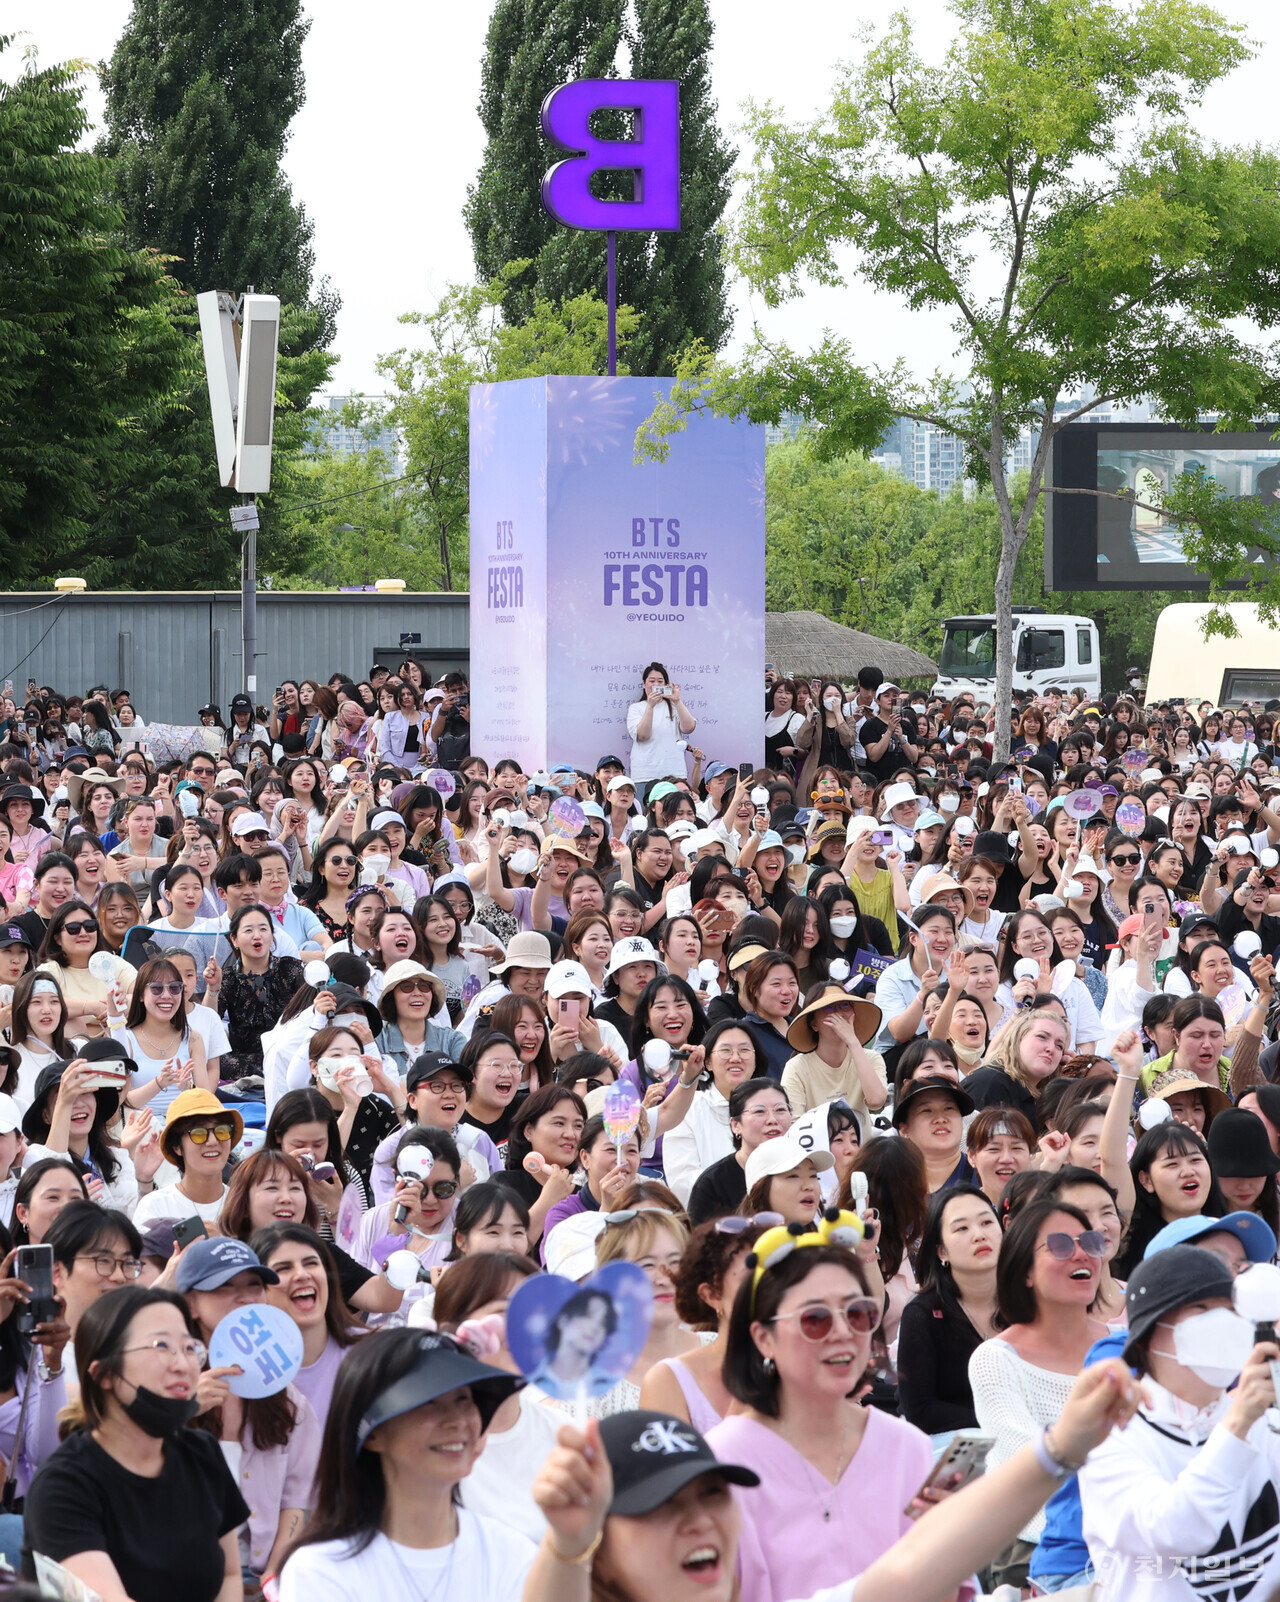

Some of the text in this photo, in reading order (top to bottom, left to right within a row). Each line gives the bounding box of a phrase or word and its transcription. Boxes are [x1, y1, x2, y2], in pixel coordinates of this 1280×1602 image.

[497, 521, 513, 550] BTS
[632, 517, 680, 548] BTS
[603, 551, 708, 560] 10TH ANNIVERSARY
[487, 566, 523, 608] FESTA
[603, 563, 708, 606] FESTA
[626, 613, 685, 622] @YEOUIDO
[590, 665, 604, 673] 내가
[229, 1309, 293, 1386] 정국
